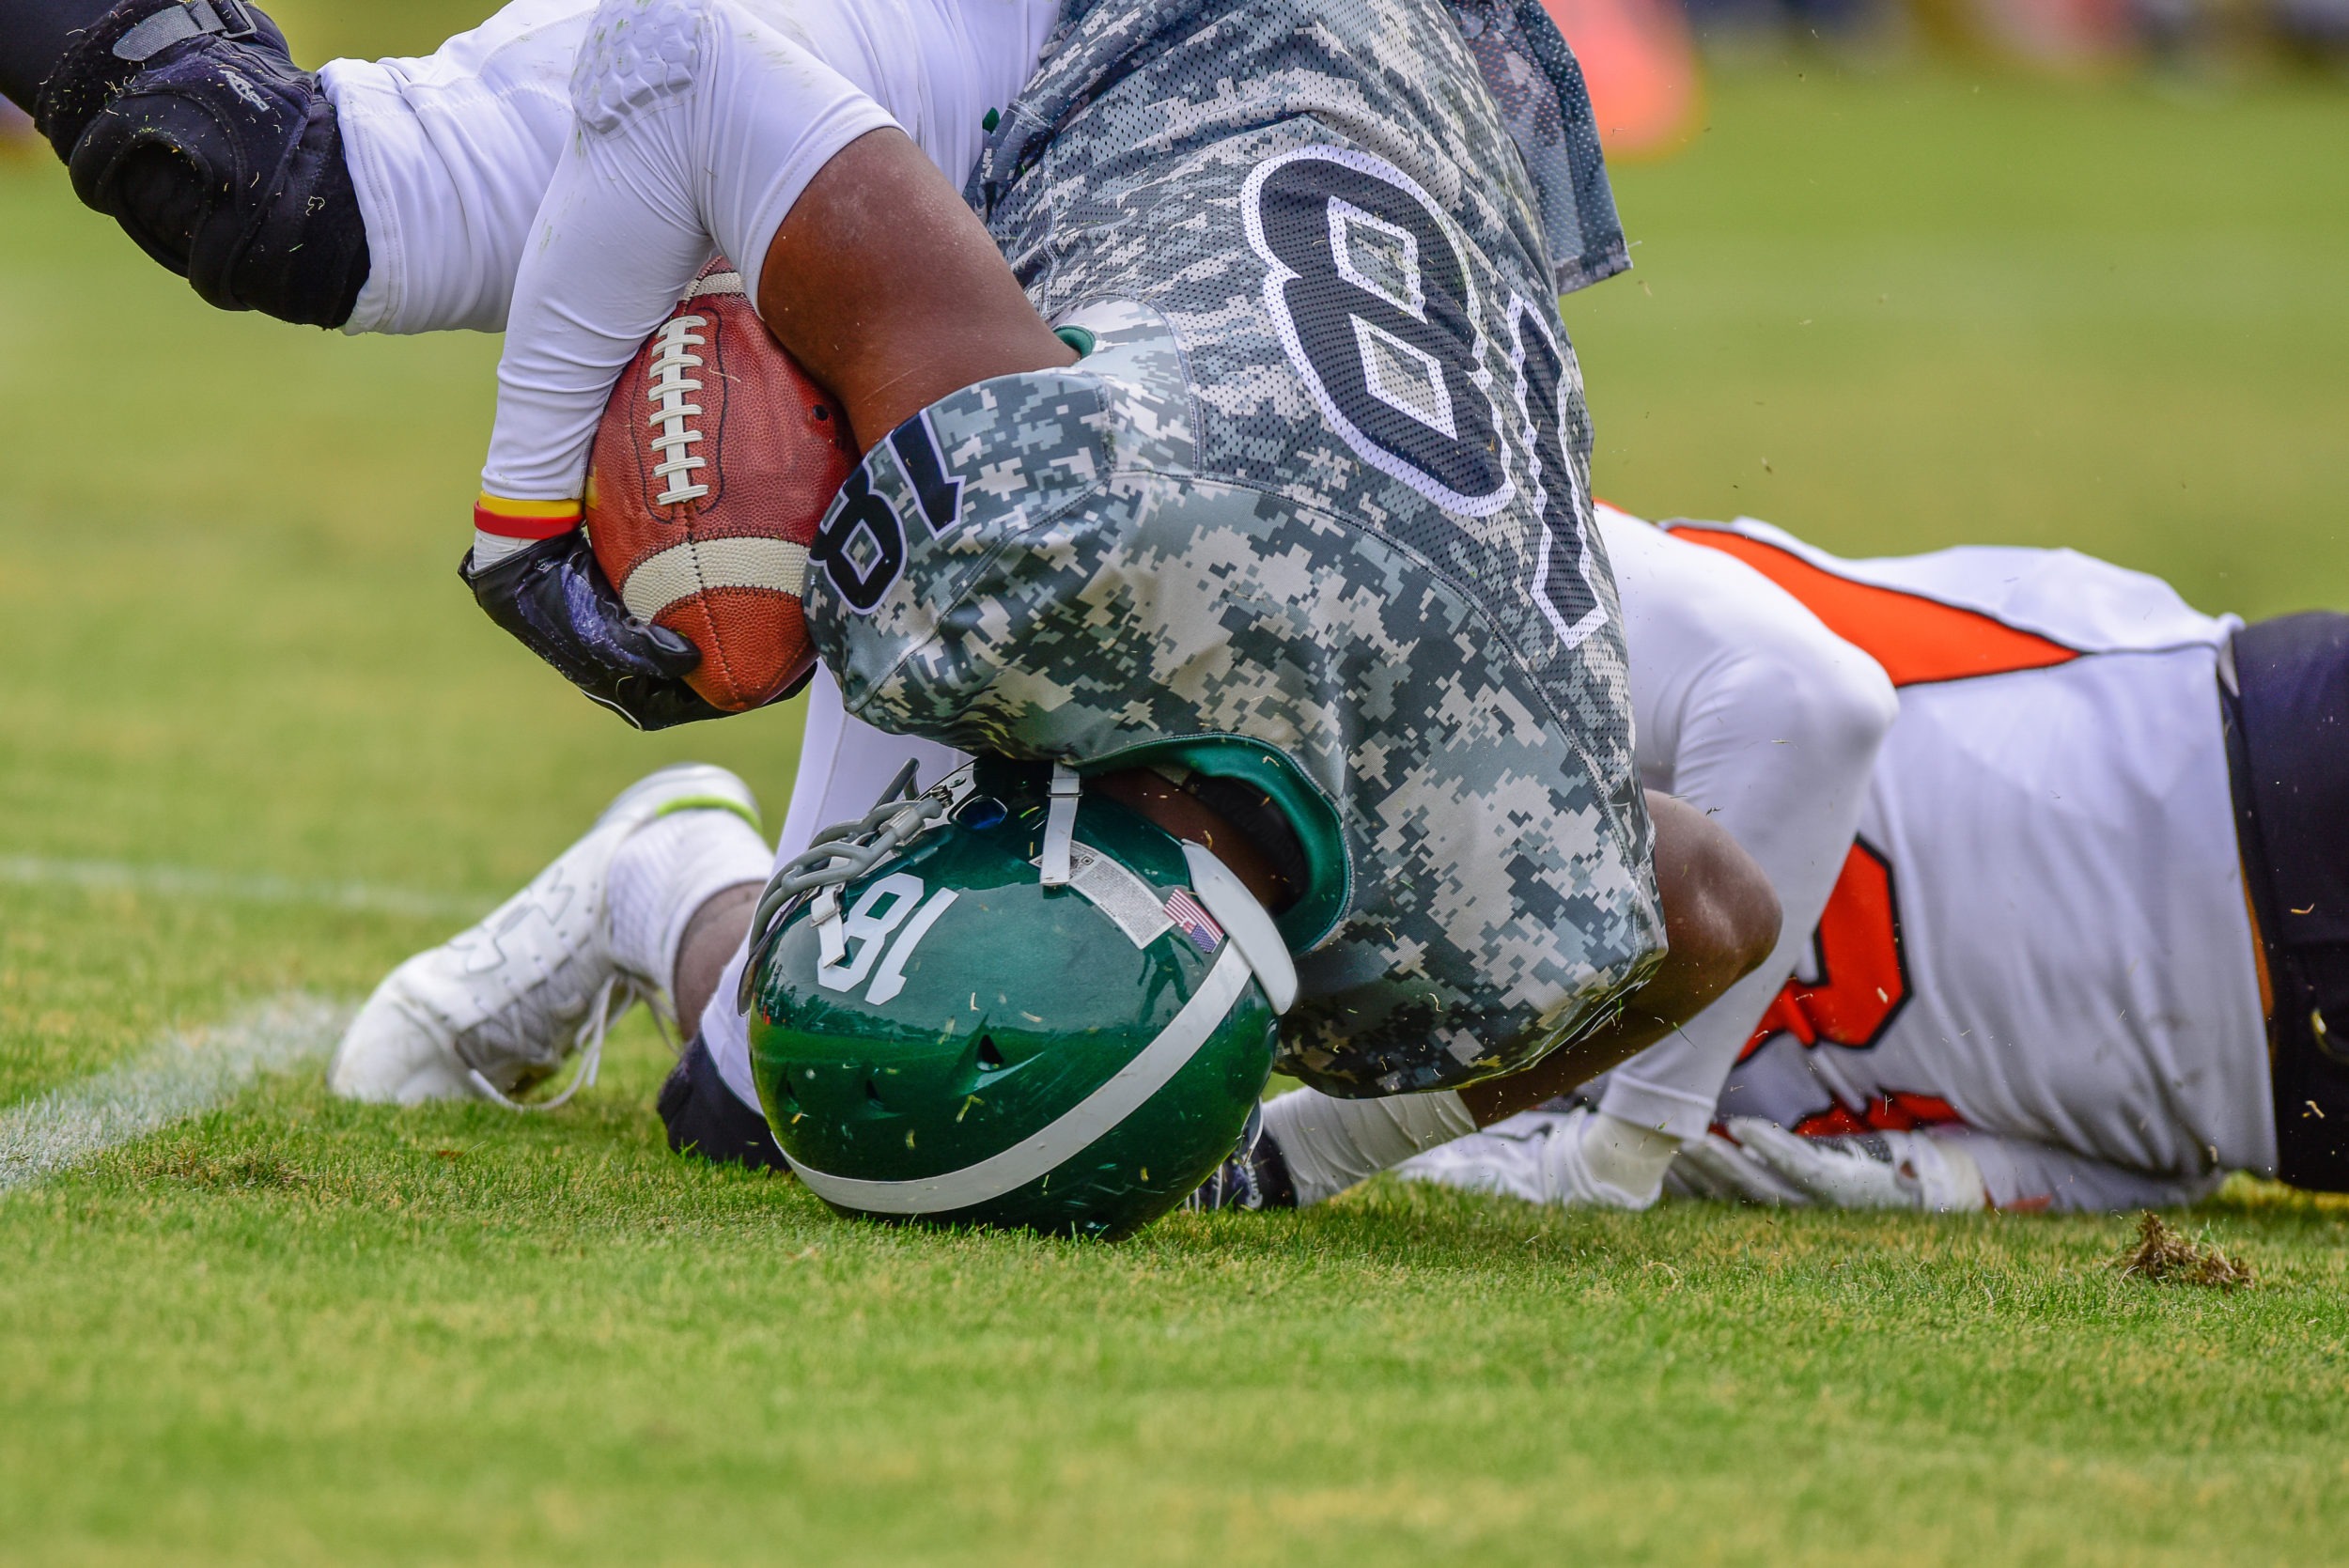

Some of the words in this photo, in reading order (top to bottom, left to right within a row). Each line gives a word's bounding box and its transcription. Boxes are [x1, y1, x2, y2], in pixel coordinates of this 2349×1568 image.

[1241, 144, 1609, 650] 18
[807, 408, 967, 615] 18
[817, 872, 959, 1006] 18
